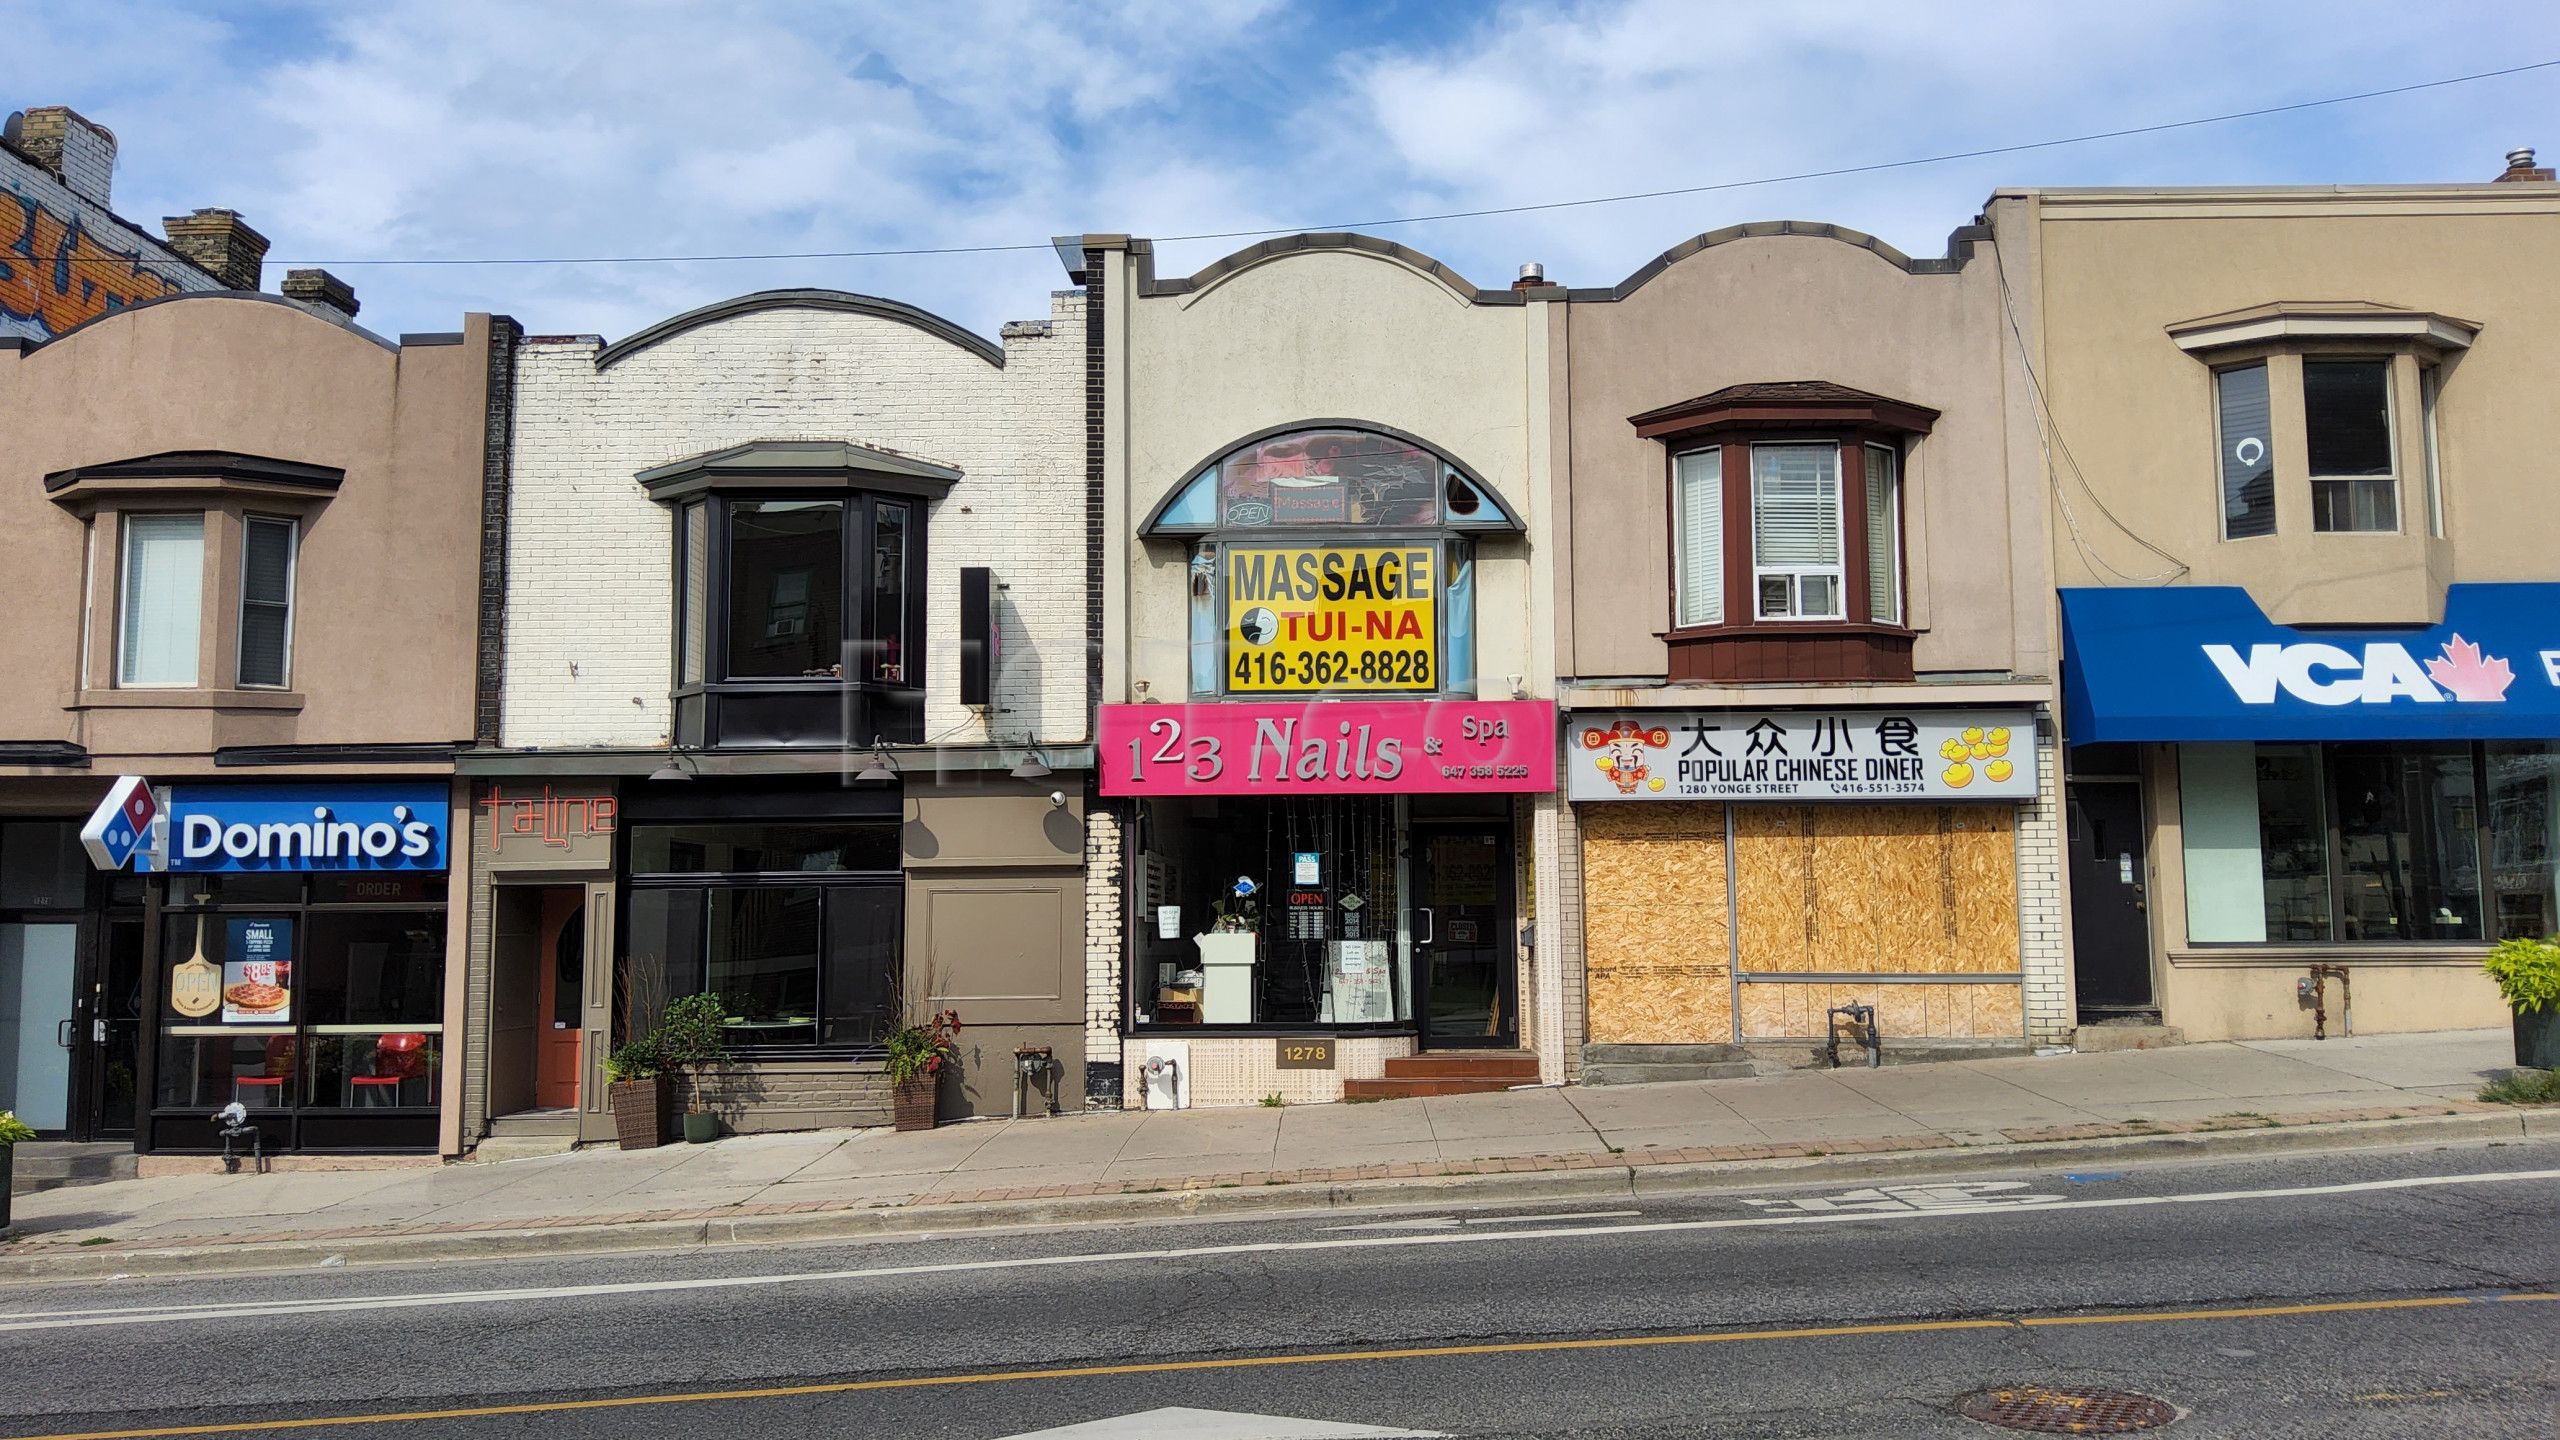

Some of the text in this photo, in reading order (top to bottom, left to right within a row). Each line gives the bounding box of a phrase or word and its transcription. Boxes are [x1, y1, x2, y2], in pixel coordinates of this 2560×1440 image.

[1227, 505, 1269, 521] OPEN
[1233, 551, 1429, 601] MASSAGE
[1280, 609, 1424, 642] TUI-NA
[1234, 649, 1430, 685] 416-362-8828
[2201, 642, 2446, 706] VCA
[1680, 716, 1919, 758] 大众小食
[1247, 717, 1405, 783] Nails
[1424, 736, 1443, 755] &
[1462, 714, 1509, 746] Spa
[1441, 764, 1529, 779] 647 358 5225
[1678, 757, 1924, 783] POPULAR CHINESE DINER
[1679, 784, 1799, 795] 1280 YONGE STREET
[1841, 783, 1925, 793] 416-551-3574
[183, 805, 430, 858] Domino's
[1298, 855, 1316, 863] PASS
[356, 882, 401, 897] ORDER
[1290, 893, 1323, 905] OPEN
[245, 929, 274, 940] SMALL
[175, 972, 219, 993] OPEN
[1284, 1046, 1326, 1061] 1278
